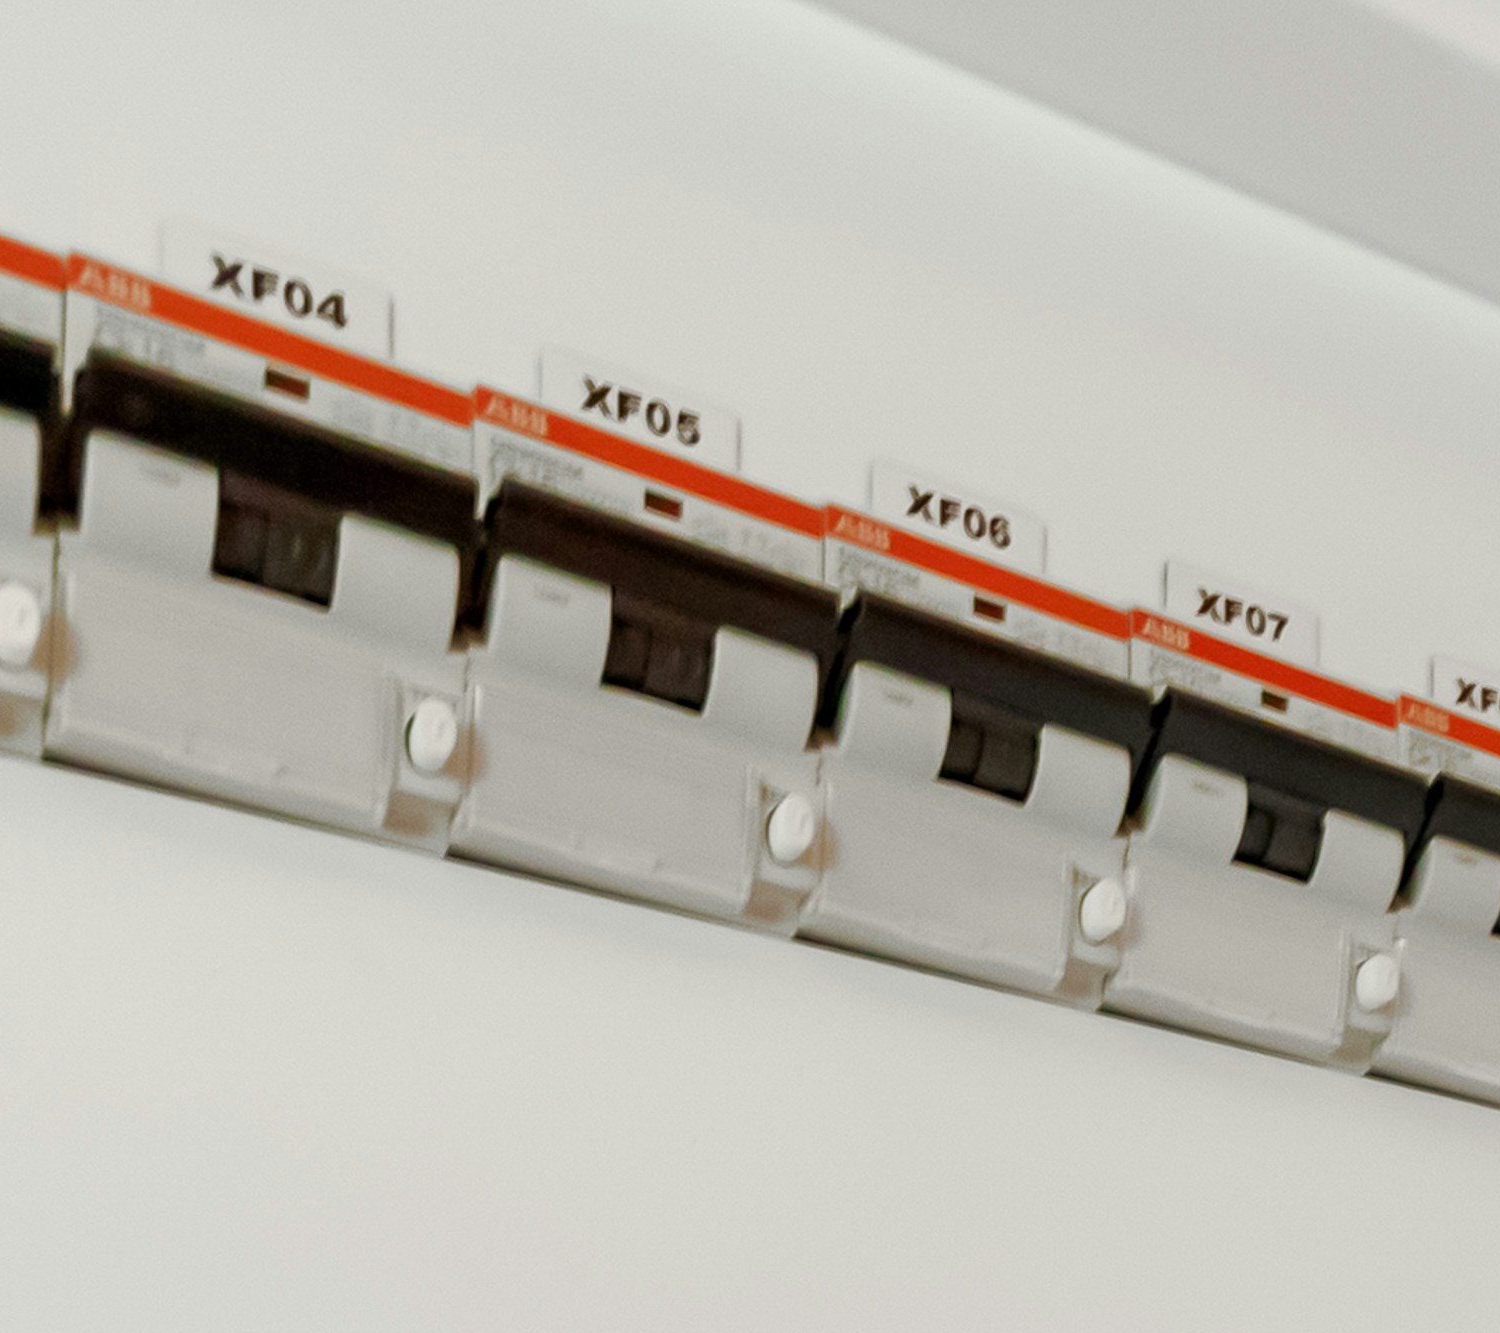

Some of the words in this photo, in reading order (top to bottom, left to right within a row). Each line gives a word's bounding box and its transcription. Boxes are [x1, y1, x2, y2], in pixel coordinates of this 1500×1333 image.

[211, 255, 348, 329] XF04
[578, 378, 701, 447] XF05
[906, 486, 1011, 550] XF06
[1196, 588, 1289, 641] XF07
